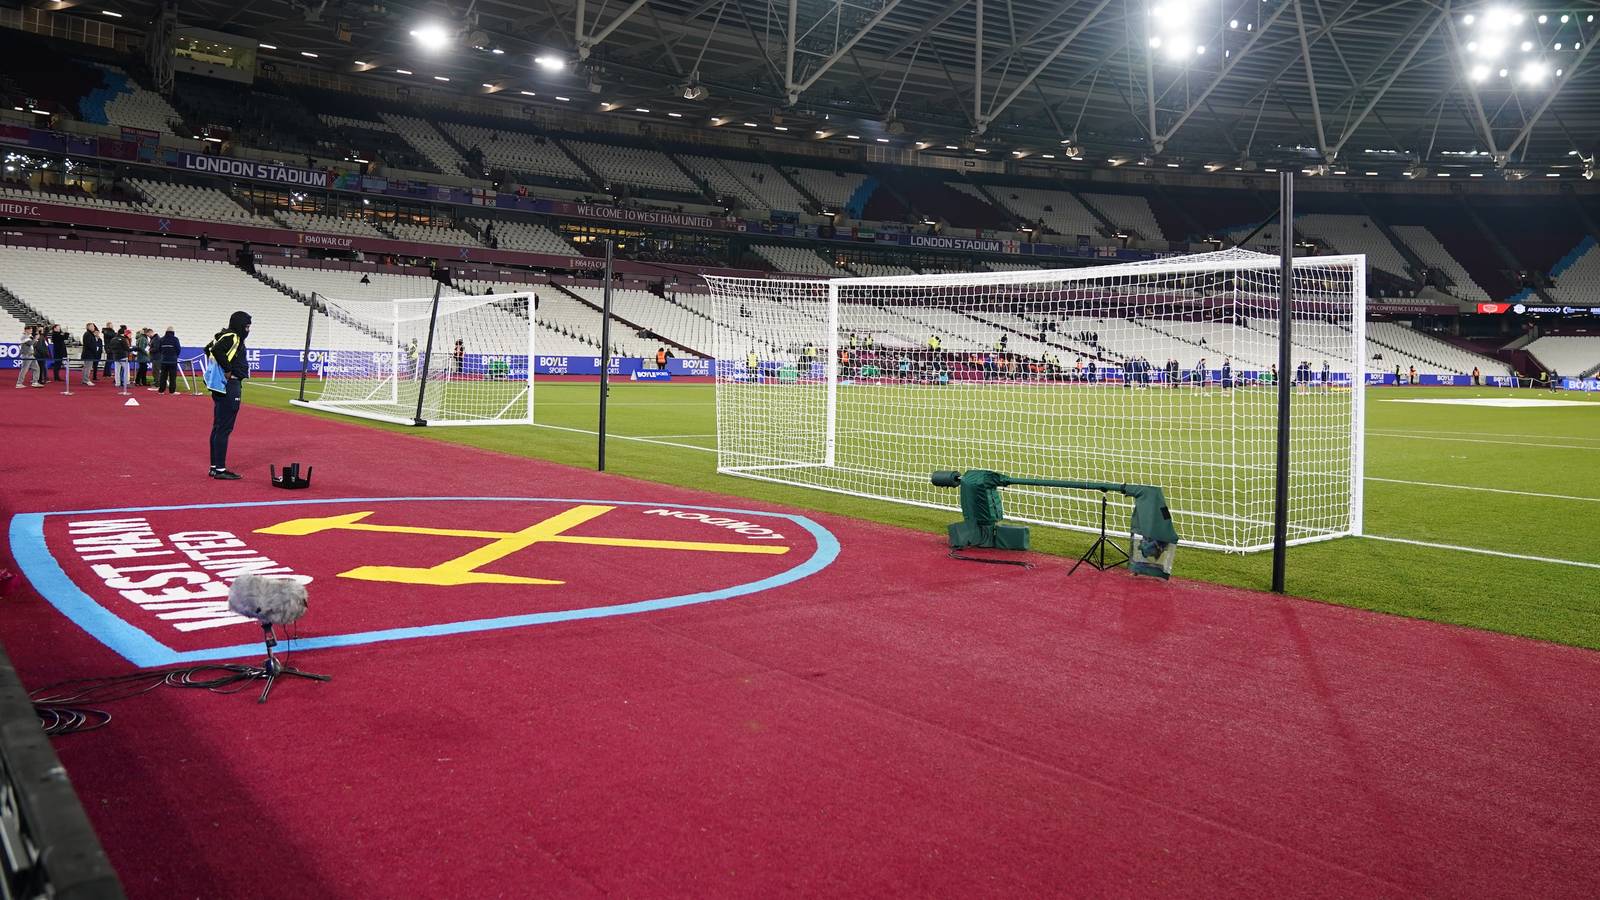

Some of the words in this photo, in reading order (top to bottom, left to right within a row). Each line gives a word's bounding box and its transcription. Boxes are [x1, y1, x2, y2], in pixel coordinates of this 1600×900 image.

[186, 154, 254, 177] LONDON
[257, 165, 327, 187] STADIUM
[23, 205, 41, 216] F.C.
[577, 205, 622, 218] WELCOME
[624, 209, 636, 220] TO
[637, 211, 660, 223] WEST
[660, 213, 681, 225] HAM
[681, 215, 713, 228] UNITED
[304, 235, 321, 244] 1940
[321, 236, 337, 245] WAR
[337, 238, 353, 247] CUP
[910, 235, 953, 248] LONDON
[954, 239, 1000, 252] STADIUM
[540, 357, 568, 367] BOYLE
[594, 358, 620, 368] BYLE
[682, 360, 709, 369] BOYLE
[548, 367, 568, 375] SPORTS
[642, 508, 785, 539] LONDON
[68, 518, 175, 560] HAM
[90, 562, 259, 632] WEST
